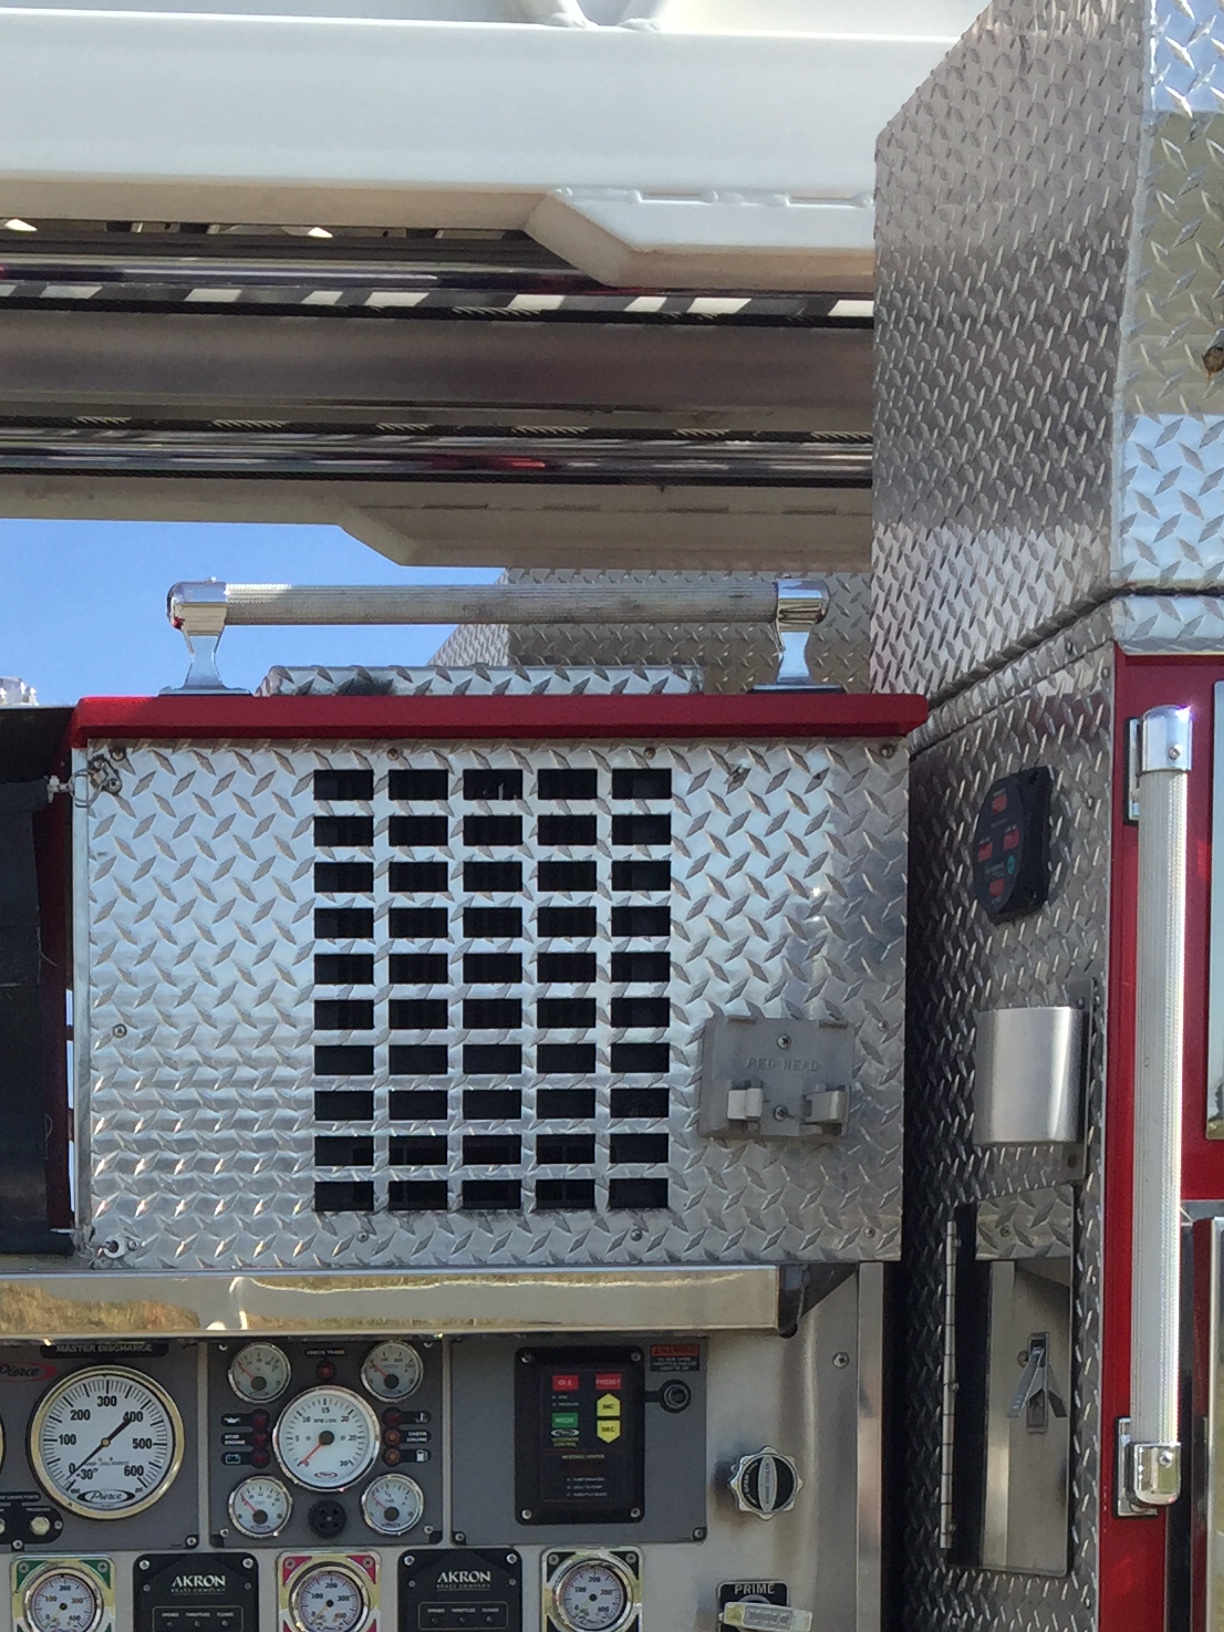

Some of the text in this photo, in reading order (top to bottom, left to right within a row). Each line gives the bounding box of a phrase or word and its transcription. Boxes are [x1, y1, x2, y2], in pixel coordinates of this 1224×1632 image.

[746, 1057, 820, 1072] RED HEAD
[56, 1343, 153, 1352] MASTER DISCHARGE
[97, 1396, 117, 1406] 300
[70, 1410, 90, 1420] 200
[123, 1411, 143, 1422] 400
[59, 1435, 76, 1445] 100
[132, 1438, 152, 1449] 500
[124, 1465, 144, 1476] 600
[90, 1491, 123, 1500] Pierce
[172, 1575, 226, 1587] AKRON
[437, 1571, 491, 1583] AKRON
[734, 1584, 775, 1594] PRIME
